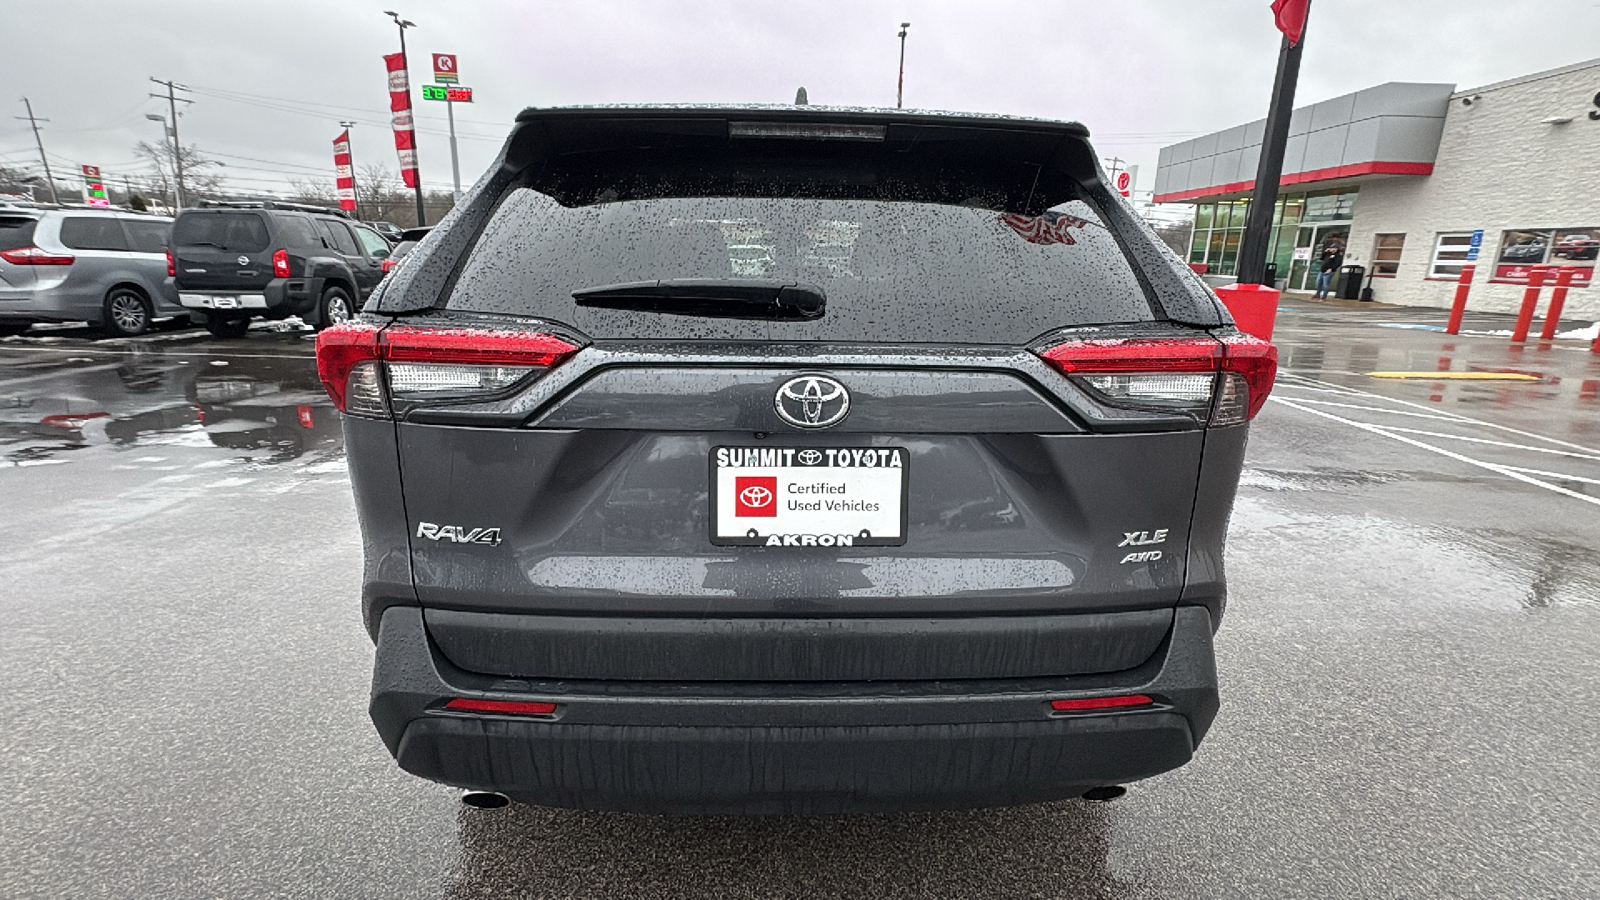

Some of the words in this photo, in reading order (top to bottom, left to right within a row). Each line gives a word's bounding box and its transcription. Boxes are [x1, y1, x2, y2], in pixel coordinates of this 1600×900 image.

[717, 448, 795, 467] SUMMIT
[826, 449, 902, 468] TOYOTA
[787, 482, 846, 494] Certified
[787, 500, 821, 511] Used
[825, 500, 880, 511] Vehicles
[416, 521, 502, 546] RAV4
[766, 534, 854, 546] AKRON
[1117, 528, 1169, 547] XLE
[1120, 550, 1162, 564] AWD
